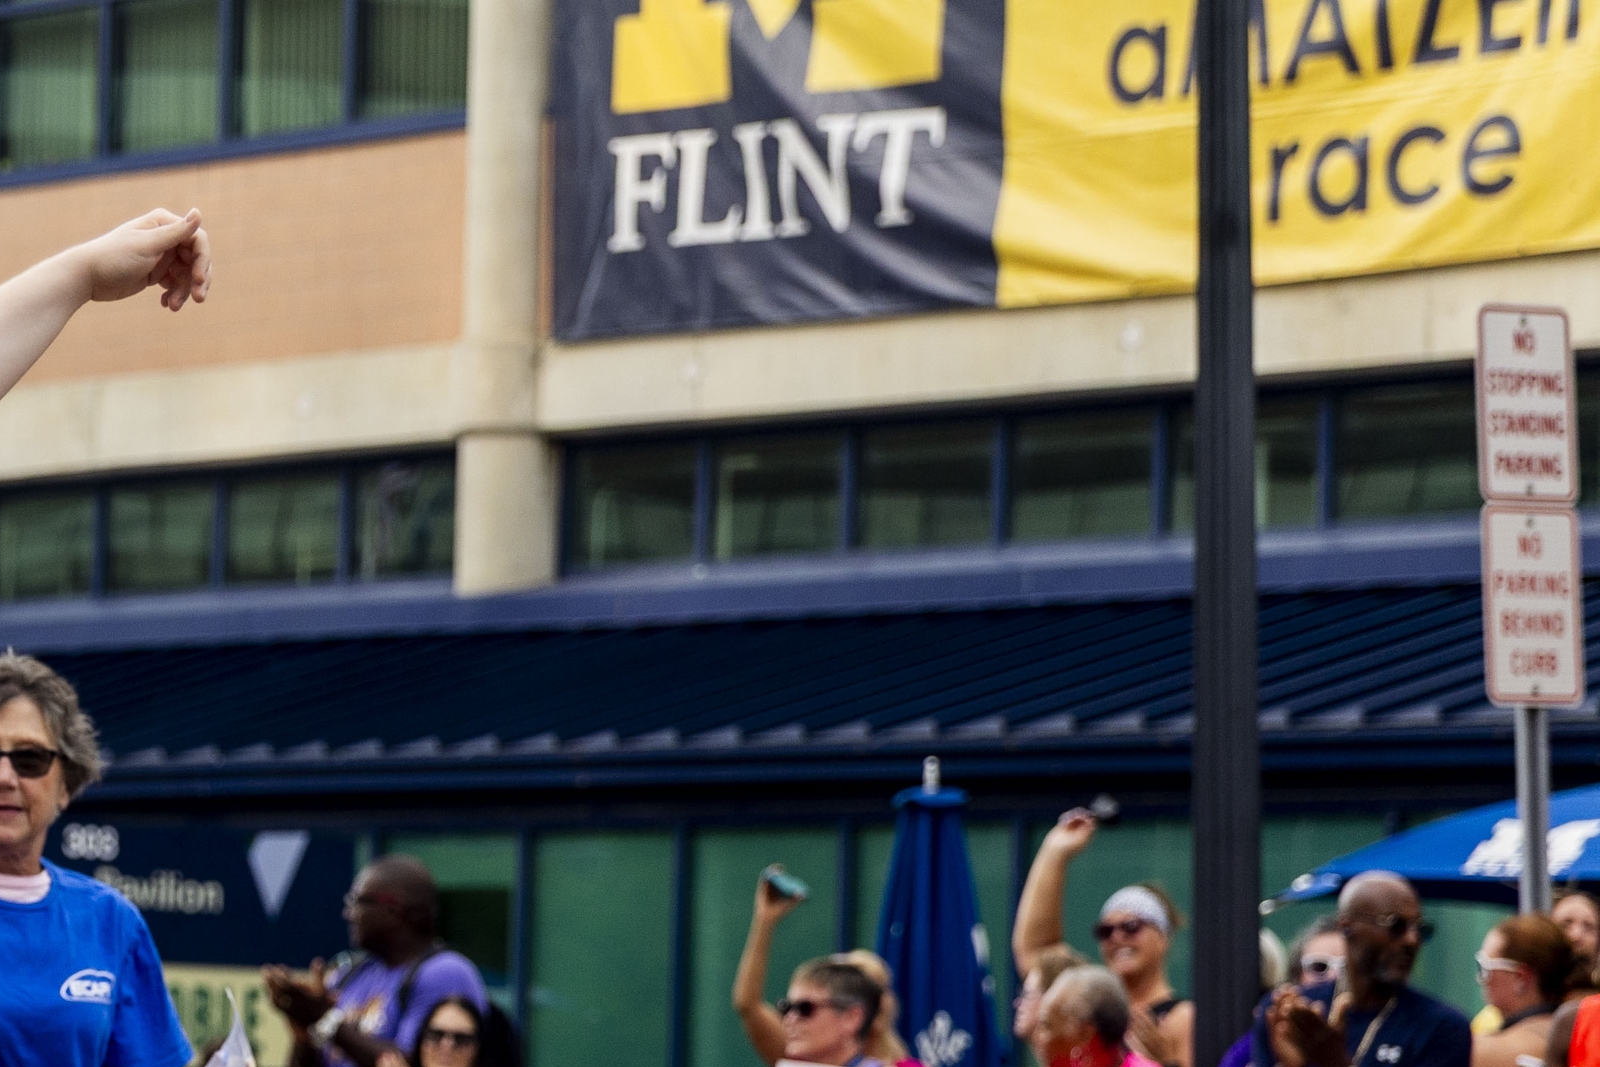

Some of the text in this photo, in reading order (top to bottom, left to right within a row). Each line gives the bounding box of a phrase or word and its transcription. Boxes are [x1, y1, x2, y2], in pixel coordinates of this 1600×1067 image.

[610, 106, 946, 254] FLINT
[1265, 113, 1524, 223] race
[1512, 329, 1536, 354] NO
[1486, 369, 1564, 397] STOPPING
[1488, 410, 1565, 437] STANDING
[1495, 450, 1563, 480] PARKING
[1517, 533, 1542, 559] NO
[1495, 569, 1568, 597] PARKING
[1501, 609, 1565, 639] BEHIND
[1510, 649, 1558, 676] CURB
